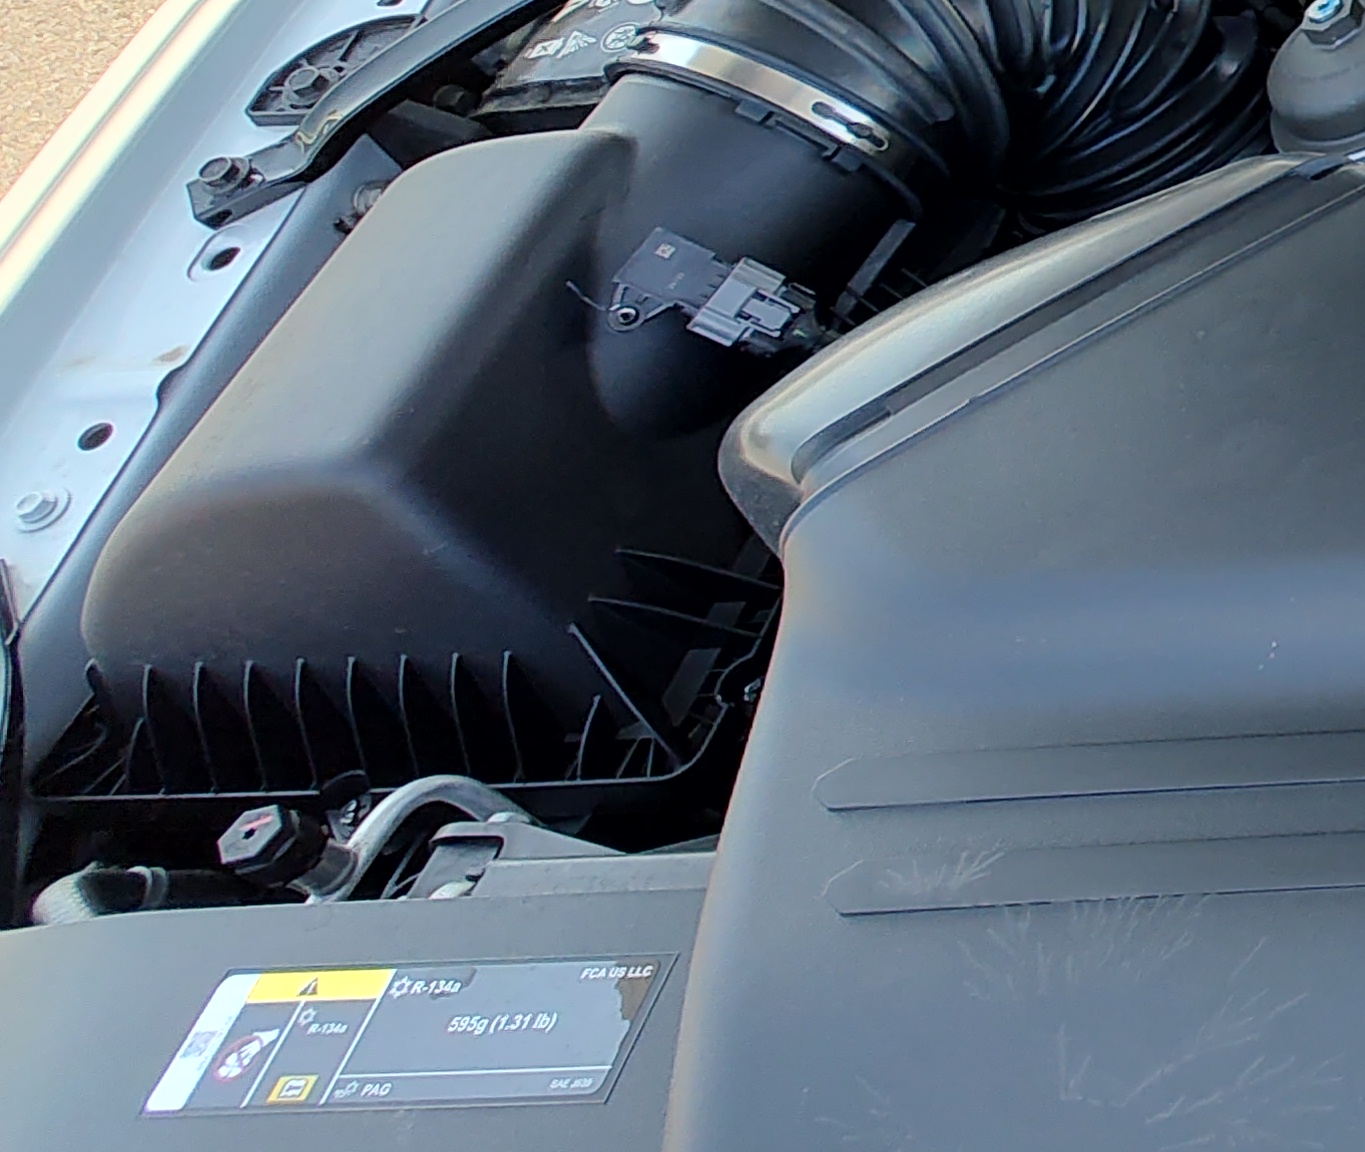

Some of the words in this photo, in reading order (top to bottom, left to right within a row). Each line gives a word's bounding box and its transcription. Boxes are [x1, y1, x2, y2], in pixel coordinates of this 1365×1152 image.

[580, 967, 606, 979] FCA
[607, 966, 627, 979] US
[626, 965, 653, 978] LLC
[410, 980, 462, 995] R-134a
[307, 1022, 348, 1035] R-134a
[447, 1015, 489, 1035] 595g
[489, 1013, 533, 1035] (1.31
[532, 1012, 558, 1034] lb)
[360, 1082, 392, 1097] PAG
